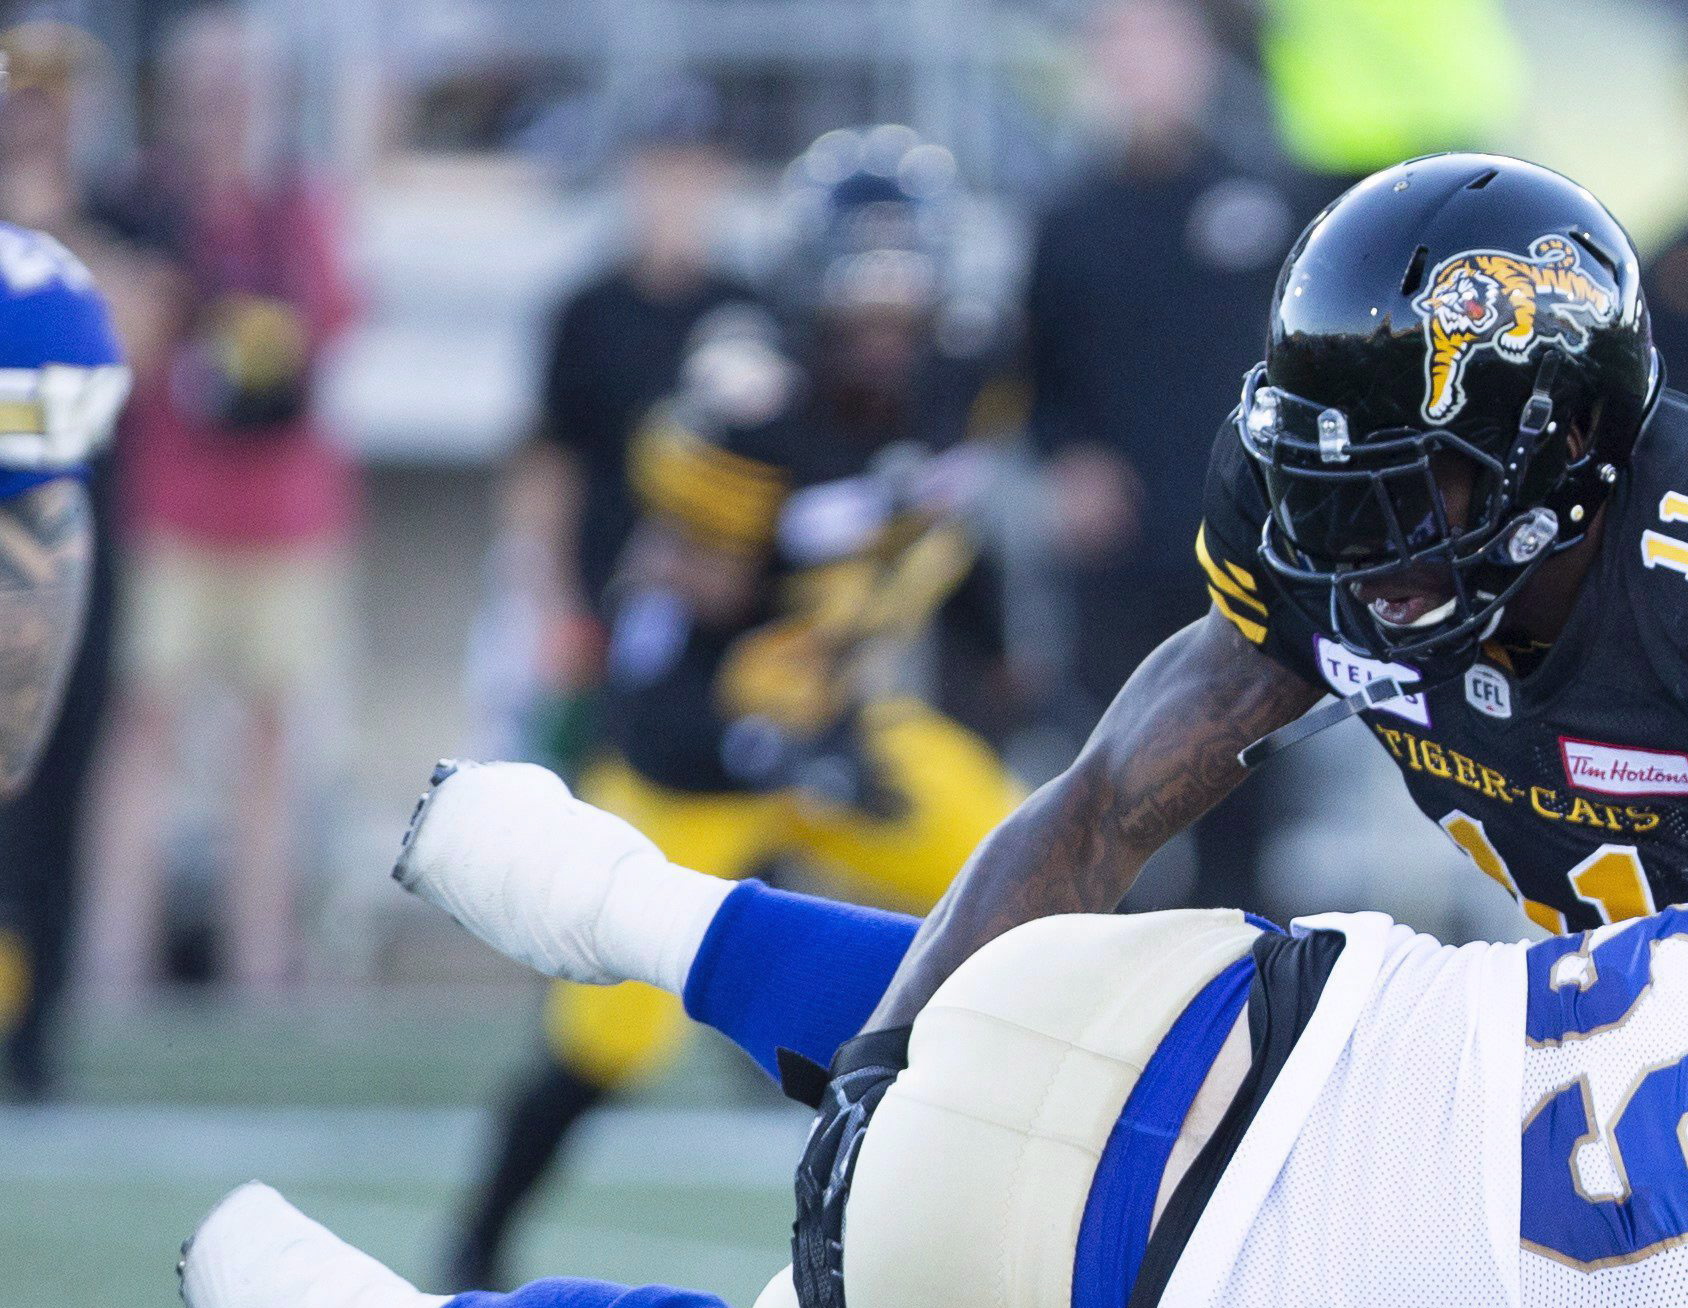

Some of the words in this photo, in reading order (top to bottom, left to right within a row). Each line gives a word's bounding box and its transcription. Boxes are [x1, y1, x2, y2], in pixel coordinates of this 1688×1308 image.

[1472, 677, 1504, 707] CFL
[1376, 723, 1661, 832] TIGER-CATS
[1569, 755, 1607, 780] Tim
